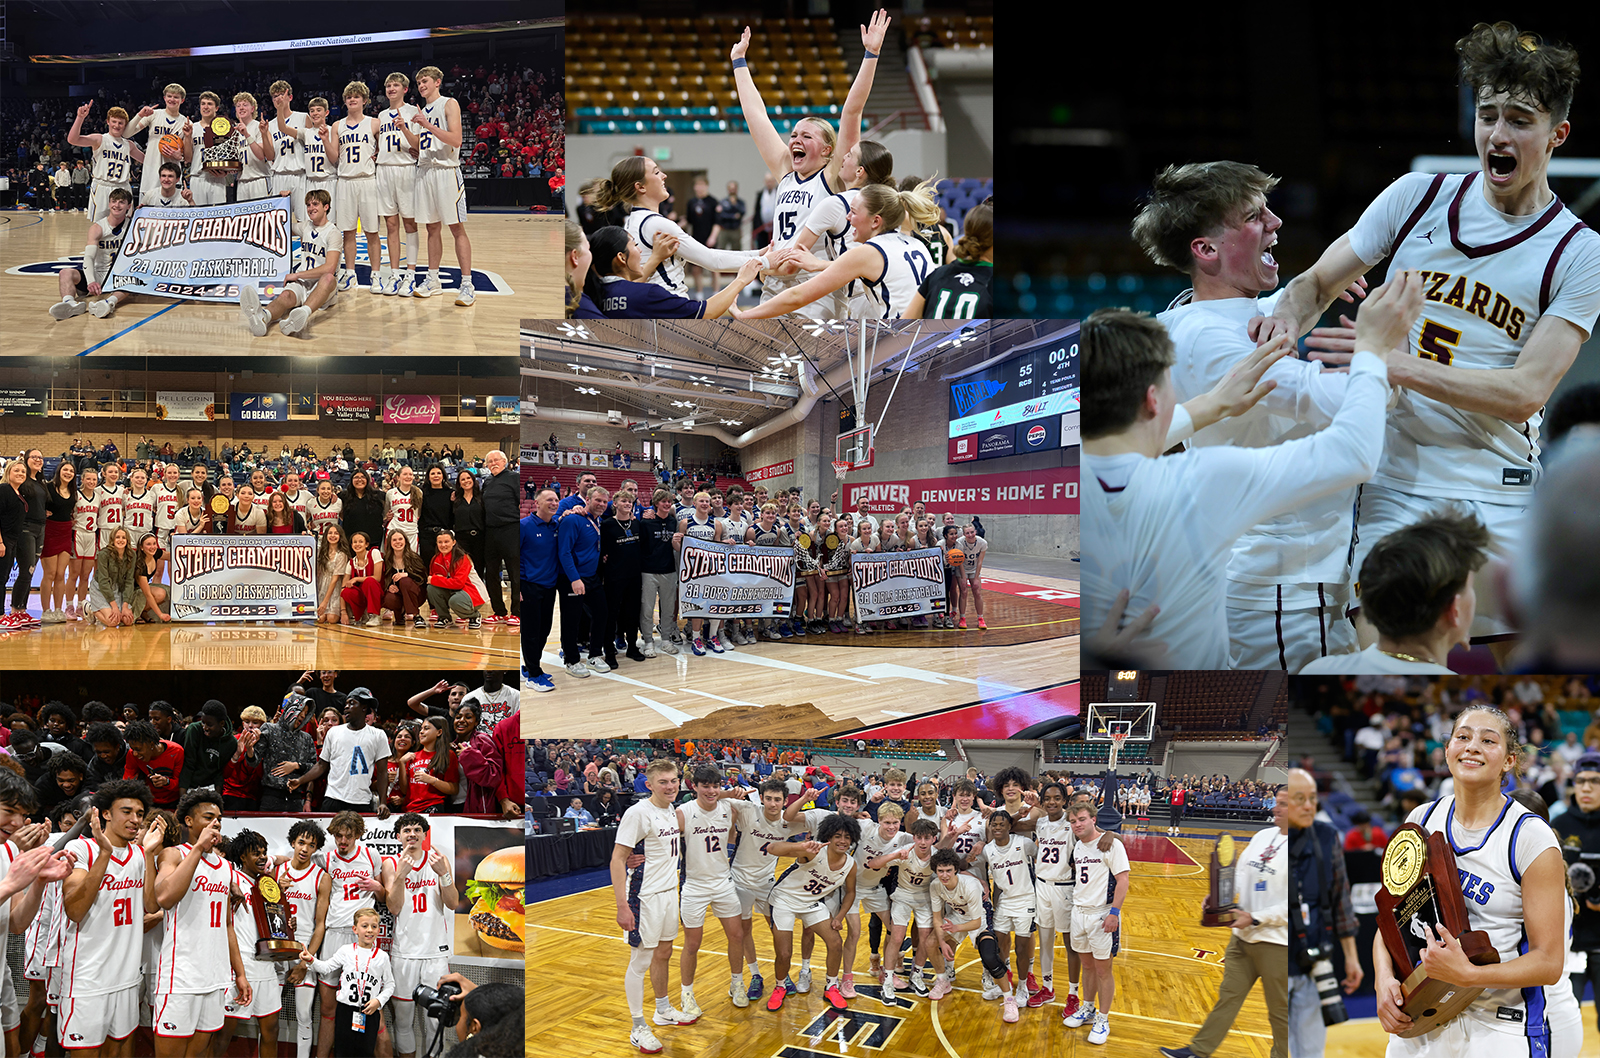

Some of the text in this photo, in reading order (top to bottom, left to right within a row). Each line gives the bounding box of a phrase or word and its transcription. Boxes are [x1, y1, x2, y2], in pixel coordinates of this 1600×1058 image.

[289, 35, 372, 48] RainDanceNational.com
[338, 133, 369, 146] SIMLA
[386, 134, 401, 153] 14
[102, 150, 130, 164] SIMLA
[280, 141, 294, 157] 24
[304, 144, 326, 154] SIML
[345, 145, 360, 164] 15
[107, 162, 124, 179] 23
[310, 156, 325, 173] 12
[148, 202, 276, 219] COLORADO HIGH SCHOOL
[124, 210, 287, 258] STATE CHAMPIONS
[778, 211, 797, 241] 15
[129, 259, 150, 274] 2A
[152, 259, 187, 278] BOYS
[189, 257, 277, 278] BASKETBALL
[903, 250, 928, 286] 12
[112, 274, 142, 290] CHSAA
[154, 282, 240, 298] 2024-25
[934, 288, 980, 319] 10
[1403, 270, 1526, 341] IZARDS
[1418, 318, 1462, 366] 5
[1048, 343, 1079, 364] 00.0
[1019, 364, 1033, 377] 55
[1056, 361, 1070, 370] 4TH
[1019, 378, 1032, 388] RCS
[1061, 374, 1076, 382] FOULS
[302, 396, 311, 405] N
[954, 381, 989, 413] CHSAA
[241, 410, 277, 420] GO BEARS!
[981, 439, 1010, 449] PANORAMA
[1028, 432, 1045, 440] PEPSI
[850, 484, 910, 506] DENVER
[921, 482, 1078, 503] DENVER'S HOME FO
[107, 508, 121, 523] 21
[166, 505, 175, 520] 5
[397, 508, 414, 522] 30
[867, 503, 895, 512] THLETICS
[86, 516, 94, 531] 2
[132, 512, 144, 527] 11
[174, 545, 312, 585] STATE CHAMPIONS
[681, 547, 794, 587] STATE CHAMPIONS
[853, 555, 943, 592] STATE CHAMPIONS
[183, 584, 307, 600] 1A GIRLS BASKETBALL
[686, 583, 784, 601] 3A BOYS BASKETBALL
[858, 585, 942, 604] 3A GIRLS BASKETBALL
[211, 605, 278, 616] 2024-25
[708, 604, 762, 614] 2024-25
[879, 603, 922, 615] 2024-25
[1117, 671, 1137, 680] 8:00
[692, 826, 709, 835] Kent
[670, 837, 678, 857] 11
[704, 835, 721, 853] 12
[956, 838, 973, 853] 25
[1005, 859, 1023, 868] Denver
[1041, 847, 1060, 864] 23
[910, 876, 924, 886] 10
[1006, 869, 1014, 886] 1
[1080, 866, 1089, 884] 5
[343, 883, 360, 901] 12
[405, 878, 437, 892] Raptors
[803, 879, 826, 895] 35
[285, 890, 313, 901] aptors
[412, 892, 427, 914] 10
[113, 897, 133, 927] 21
[209, 901, 222, 928] 11
[349, 983, 372, 1004] 35
